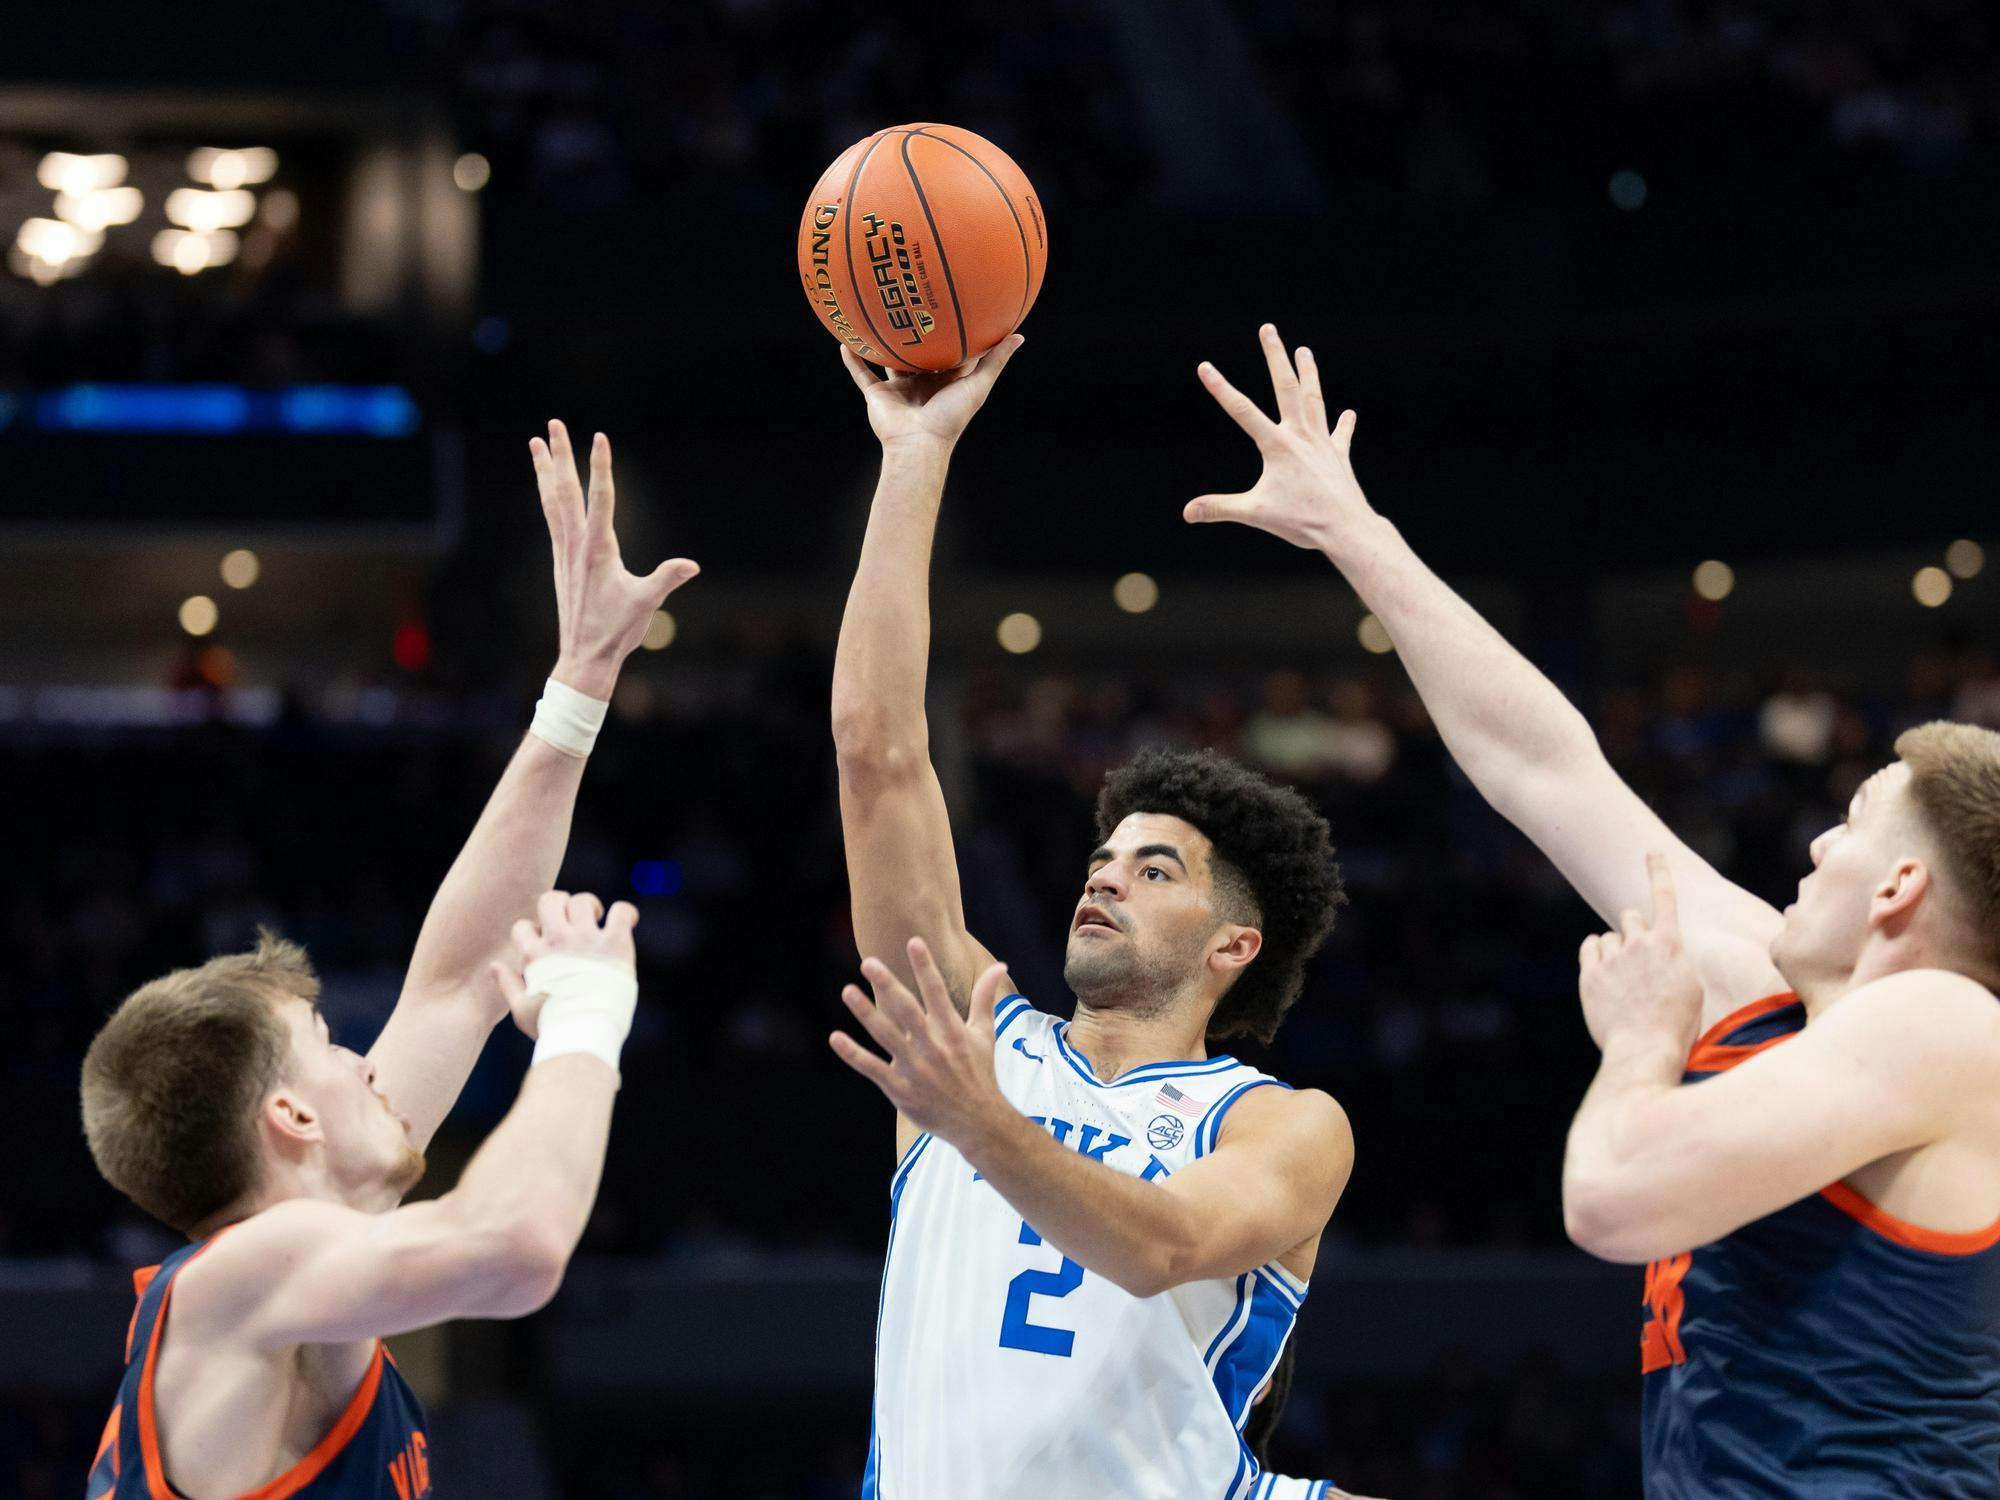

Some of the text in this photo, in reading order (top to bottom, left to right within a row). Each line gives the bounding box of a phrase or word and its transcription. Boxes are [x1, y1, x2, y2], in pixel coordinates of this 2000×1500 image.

[890, 221, 924, 307] 1000
[911, 240, 923, 260] BALL
[915, 260, 929, 280] GAME
[862, 212, 924, 347] LEGACY
[1153, 1125, 1182, 1140] ACC
[999, 1220, 1085, 1358] 2
